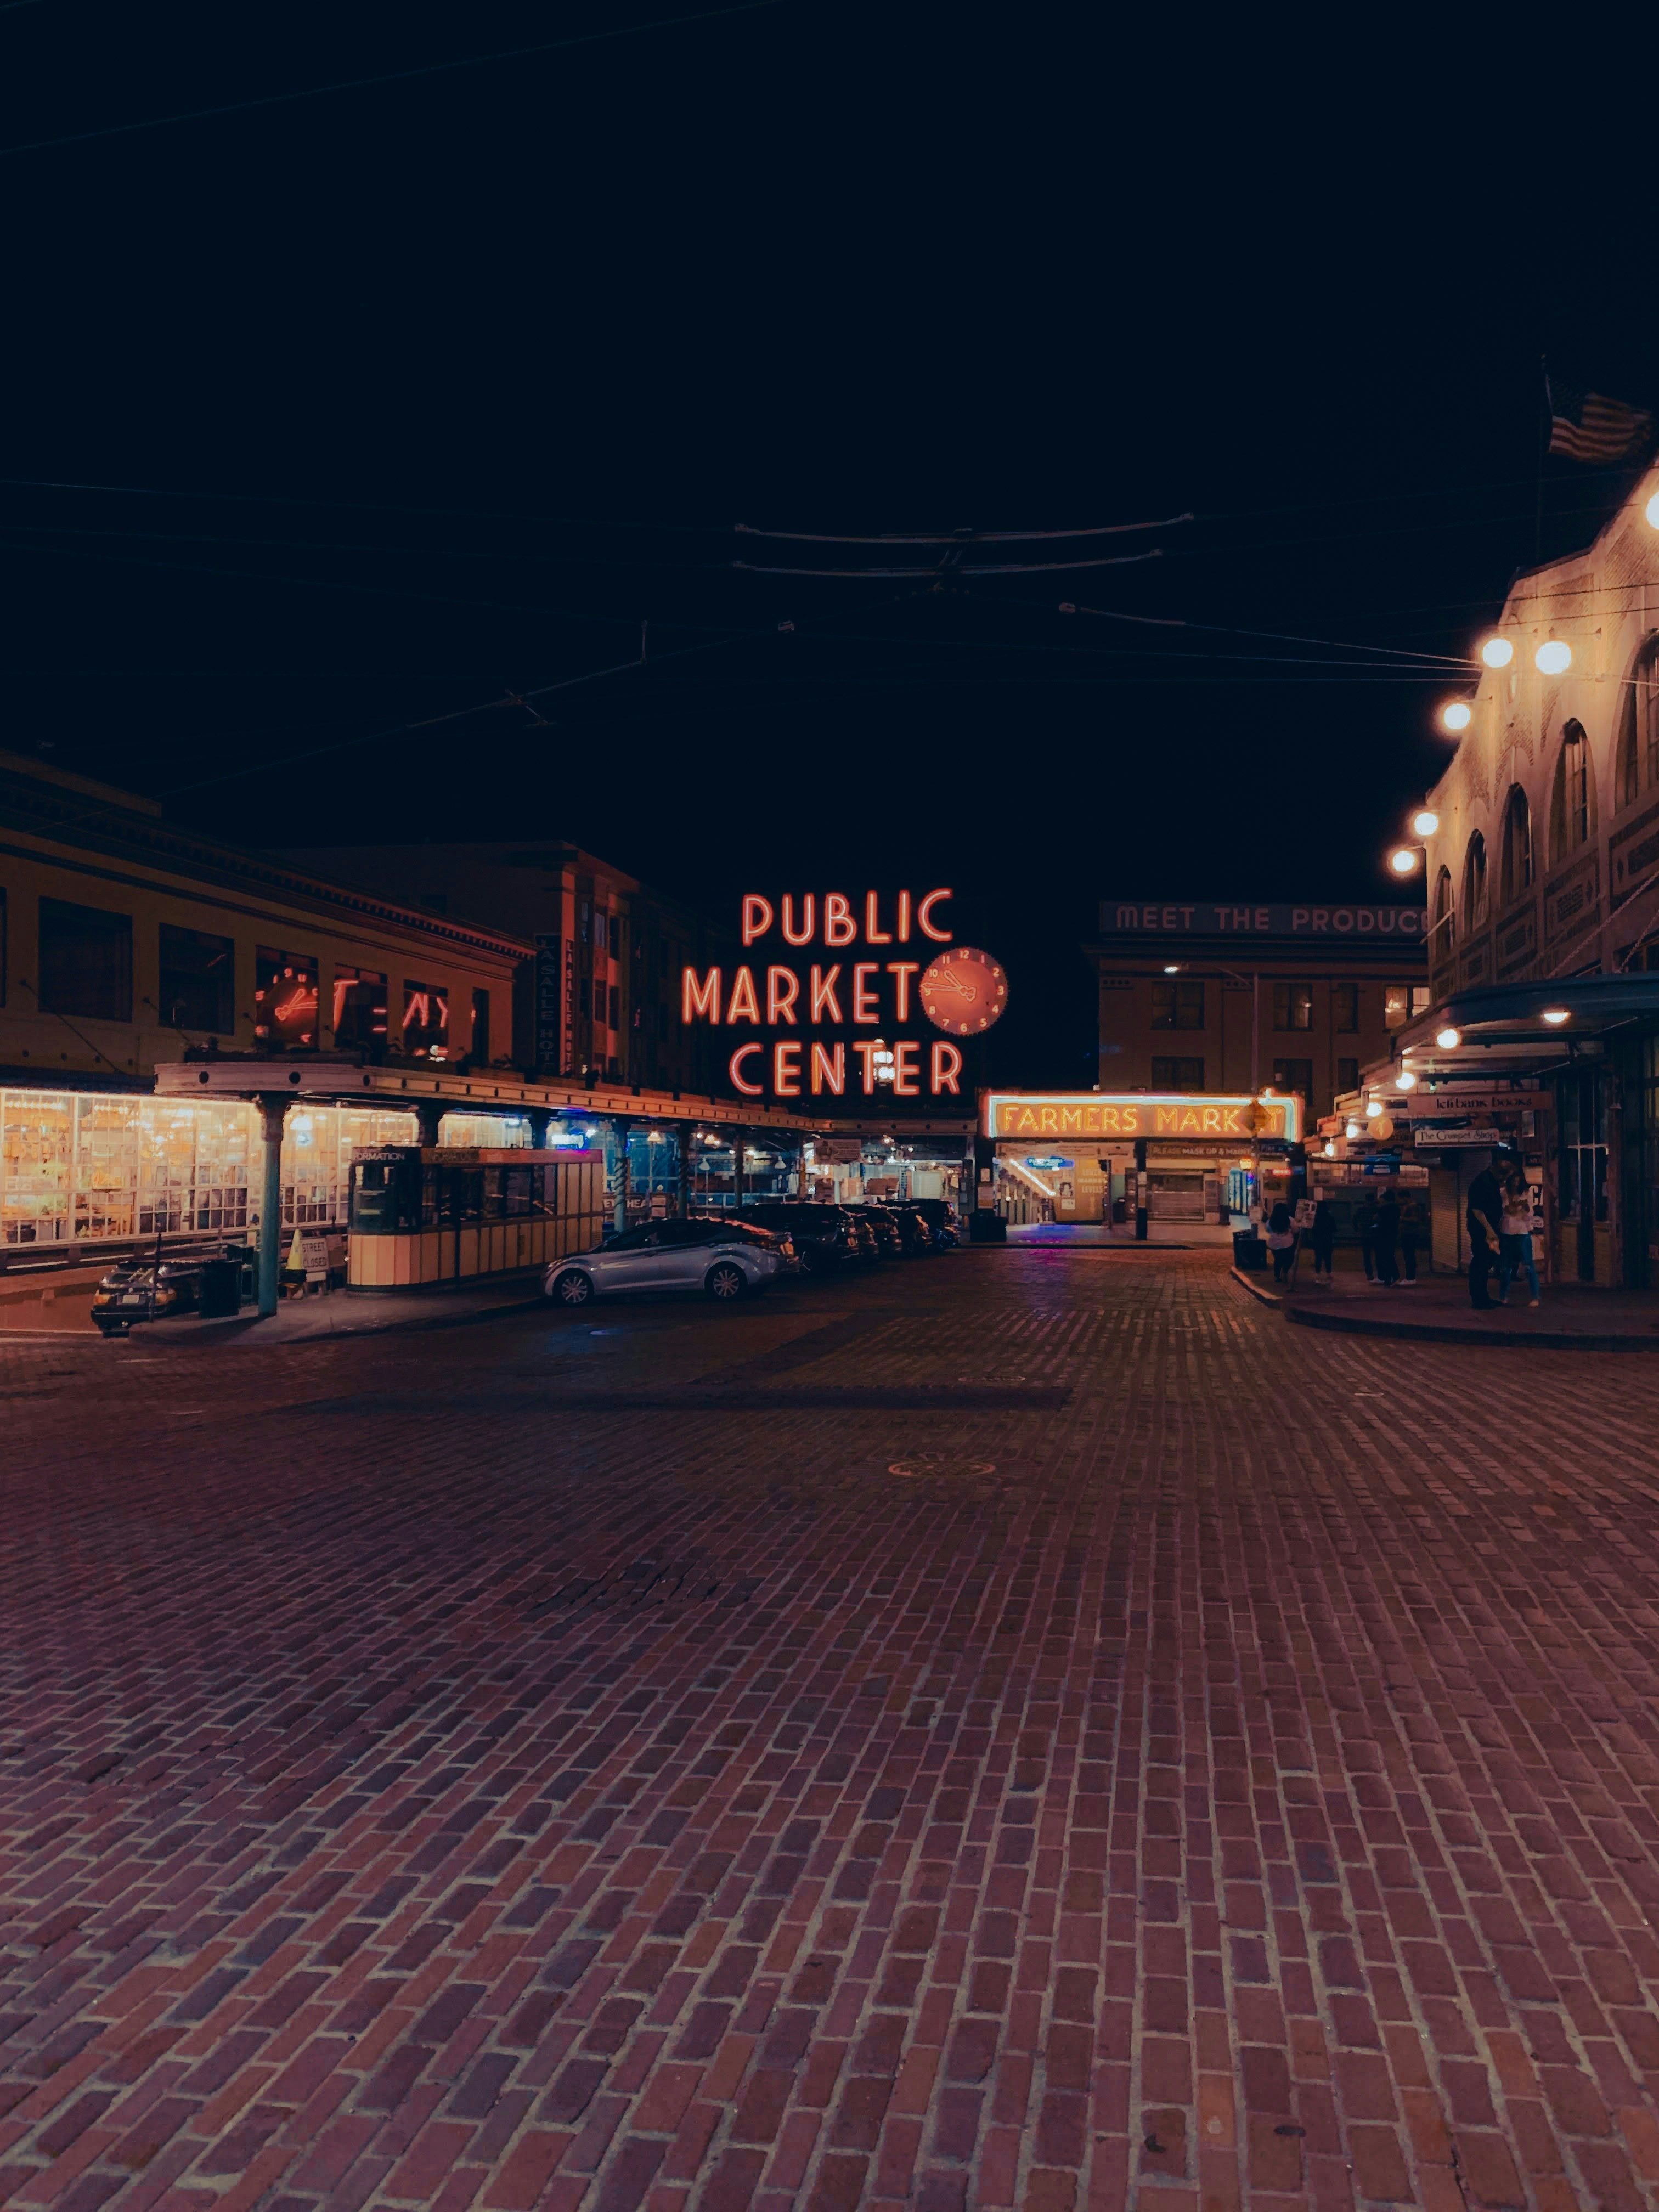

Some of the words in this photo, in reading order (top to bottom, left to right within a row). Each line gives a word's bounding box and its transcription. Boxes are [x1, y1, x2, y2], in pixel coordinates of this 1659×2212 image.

[742, 888, 954, 946] PUBLIC
[1116, 906, 1195, 929] MEET
[1214, 907, 1269, 930] THE
[960, 950, 969, 959] 12
[942, 956, 950, 964] 11
[981, 955, 985, 964] 1
[929, 969, 938, 978] 10
[993, 968, 1000, 977] 2
[682, 962, 919, 1025] MARKET
[997, 985, 1004, 995] 3
[929, 1006, 935, 1014] 8
[992, 1005, 998, 1013] 4
[942, 1018, 950, 1027] 7
[980, 1018, 987, 1027] 5
[961, 1023, 968, 1032] 6
[539, 1029, 555, 1074] HOTE
[729, 1042, 963, 1096] CENTER
[1003, 1107, 1138, 1132] FARMERS
[1156, 1107, 1282, 1132] MARKT
[1421, 1132, 1435, 1141] The
[1436, 1131, 1471, 1142] Crumpet
[302, 1242, 325, 1254] STREET
[303, 1257, 327, 1268] CLOSED
